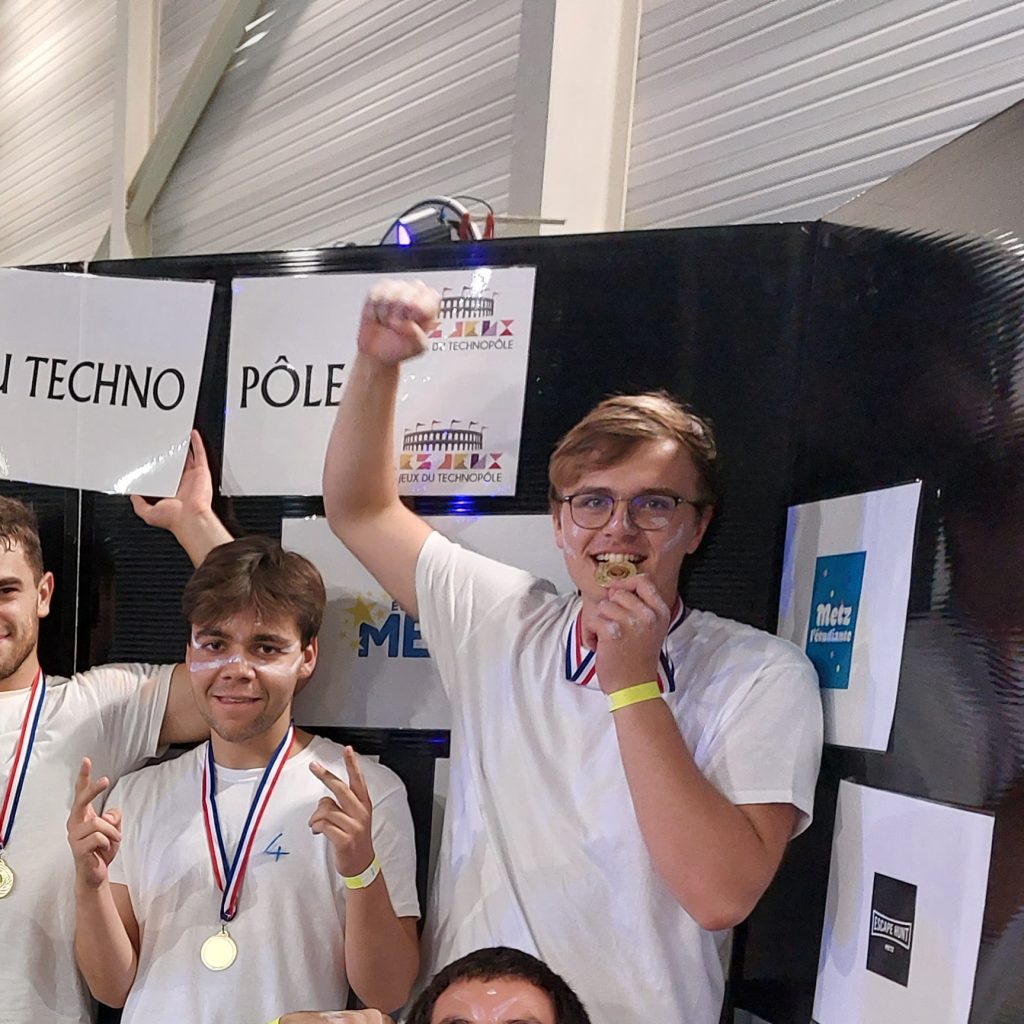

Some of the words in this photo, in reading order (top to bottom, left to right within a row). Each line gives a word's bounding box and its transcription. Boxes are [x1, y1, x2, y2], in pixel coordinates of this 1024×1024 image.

[448, 338, 514, 351] TECHNOPÔLE
[25, 356, 185, 411] TECHNO
[239, 354, 346, 409] PÔLE
[398, 473, 419, 484] JEUX
[421, 473, 435, 483] DU
[438, 471, 502, 483] TECHNOPÔLE
[816, 602, 852, 627] Metz
[263, 832, 290, 862] 4
[873, 916, 894, 936] ESCAPE
